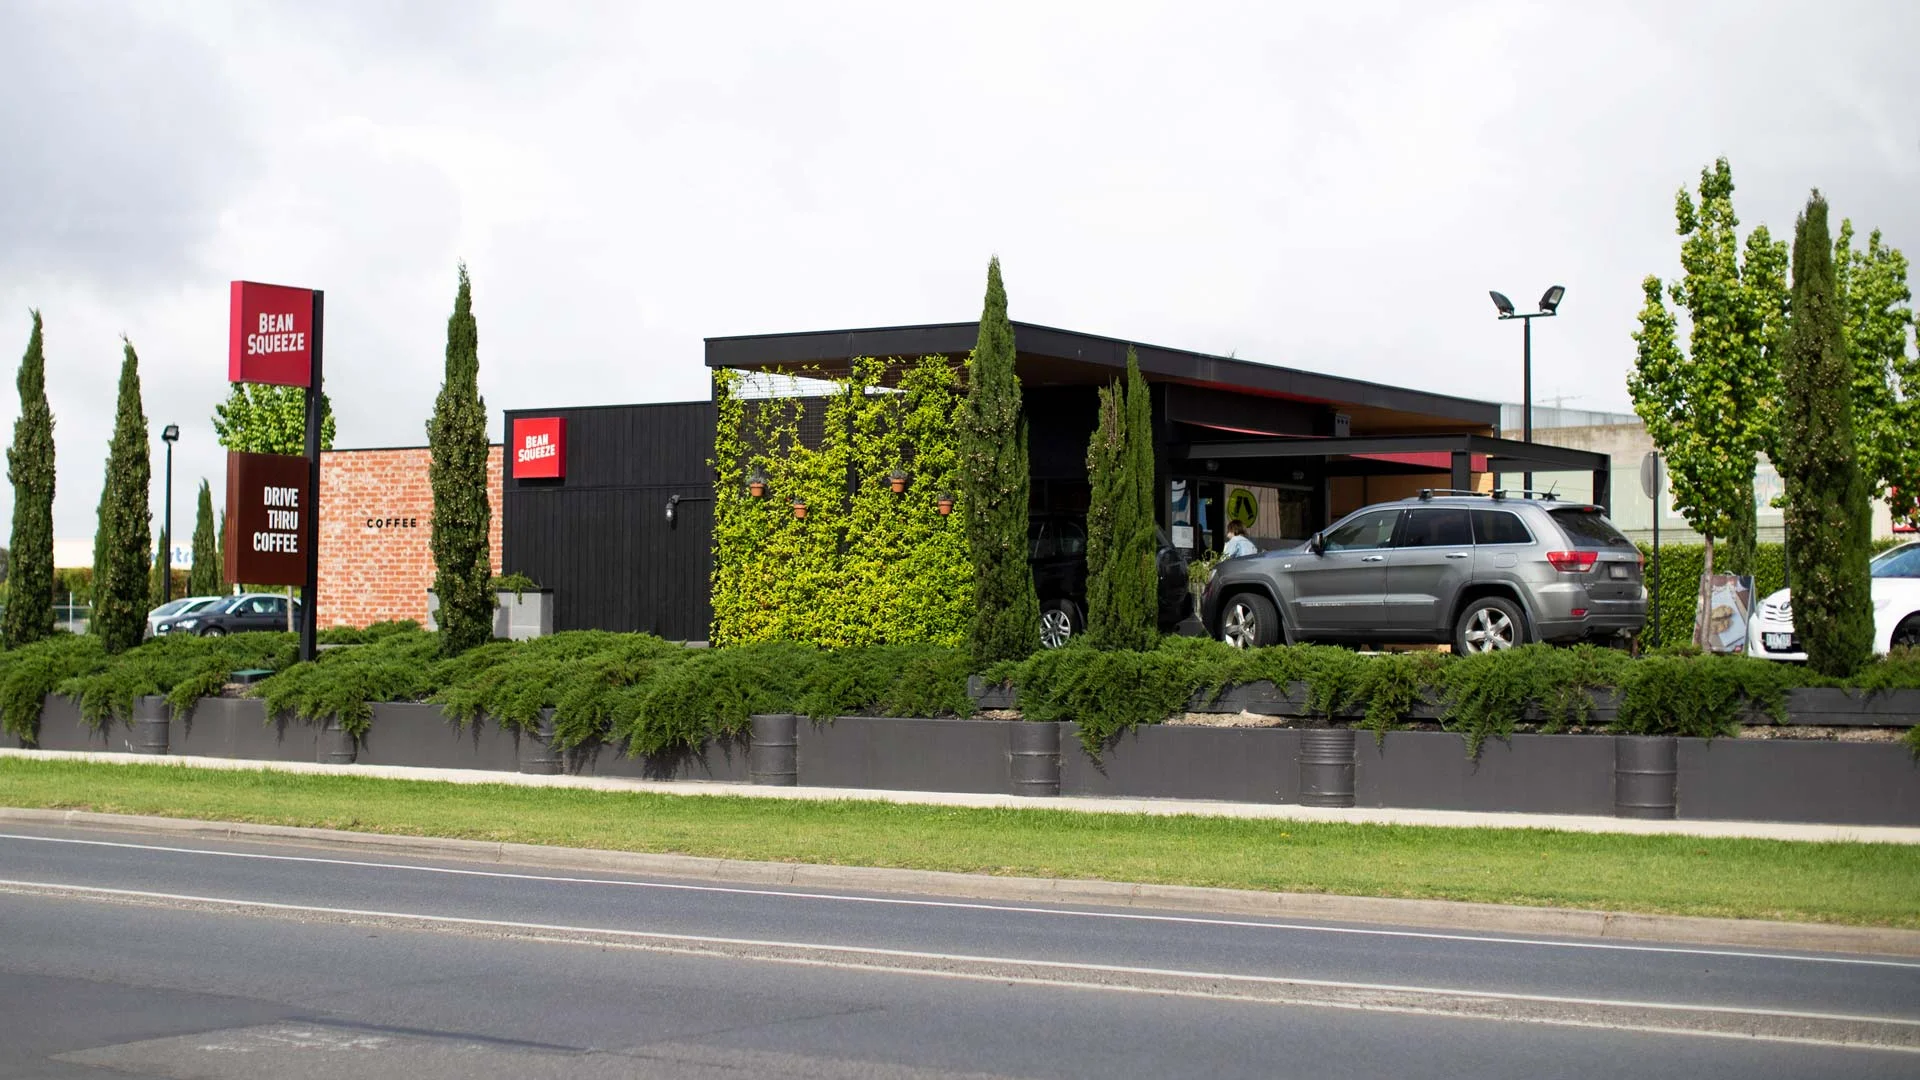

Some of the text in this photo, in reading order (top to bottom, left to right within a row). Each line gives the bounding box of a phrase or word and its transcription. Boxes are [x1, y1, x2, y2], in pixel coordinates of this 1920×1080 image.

[259, 313, 294, 334] BEAN
[247, 332, 305, 356] SQUEEZE
[525, 433, 549, 449] BEAN
[518, 444, 556, 463] SQUEEZE
[264, 486, 299, 508] DRIVE
[267, 509, 299, 530] THRU
[366, 518, 417, 529] COFFEE
[253, 531, 298, 553] COFFEE
